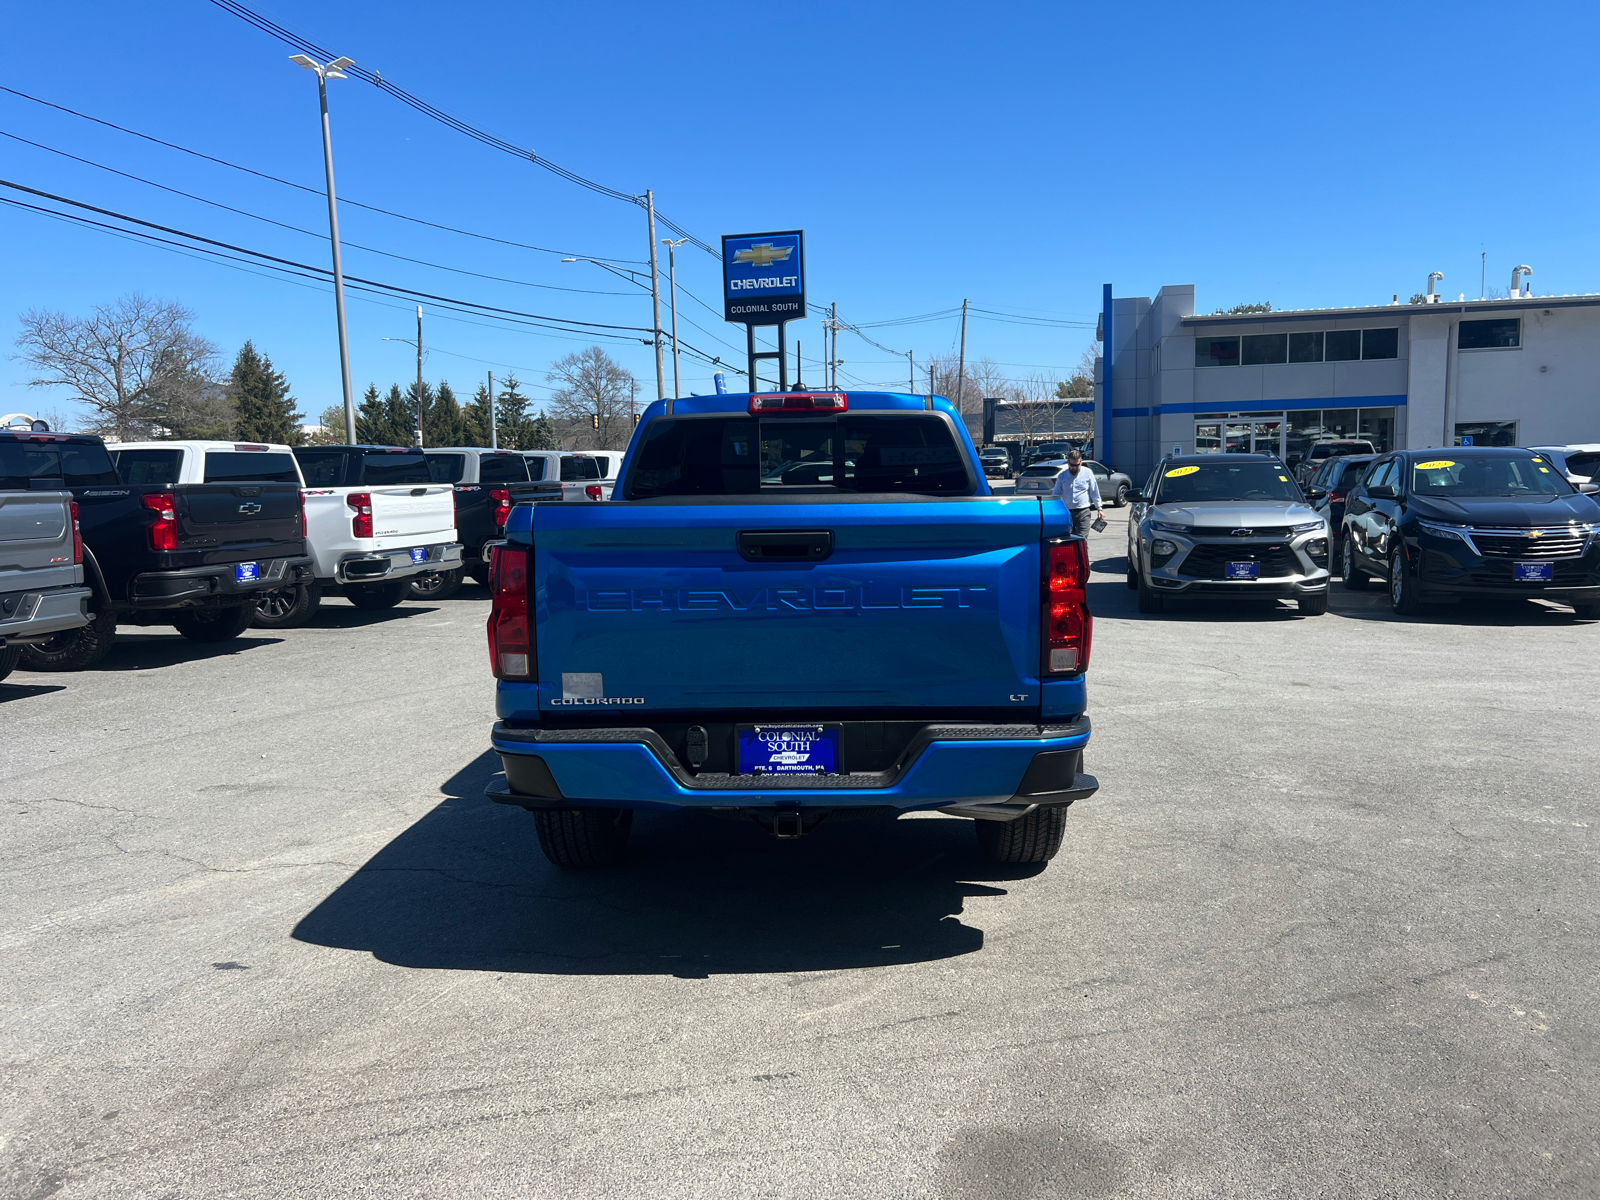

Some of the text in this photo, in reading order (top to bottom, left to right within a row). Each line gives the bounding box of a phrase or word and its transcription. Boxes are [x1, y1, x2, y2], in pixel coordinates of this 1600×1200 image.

[730, 276, 798, 290] CHEVROLET
[731, 303, 798, 314] COLONIAL SOUTH
[587, 584, 987, 611] CHEVROLET
[551, 697, 645, 705] COLORADO
[759, 732, 819, 741] COLONIAL
[768, 742, 810, 751] SOUTH
